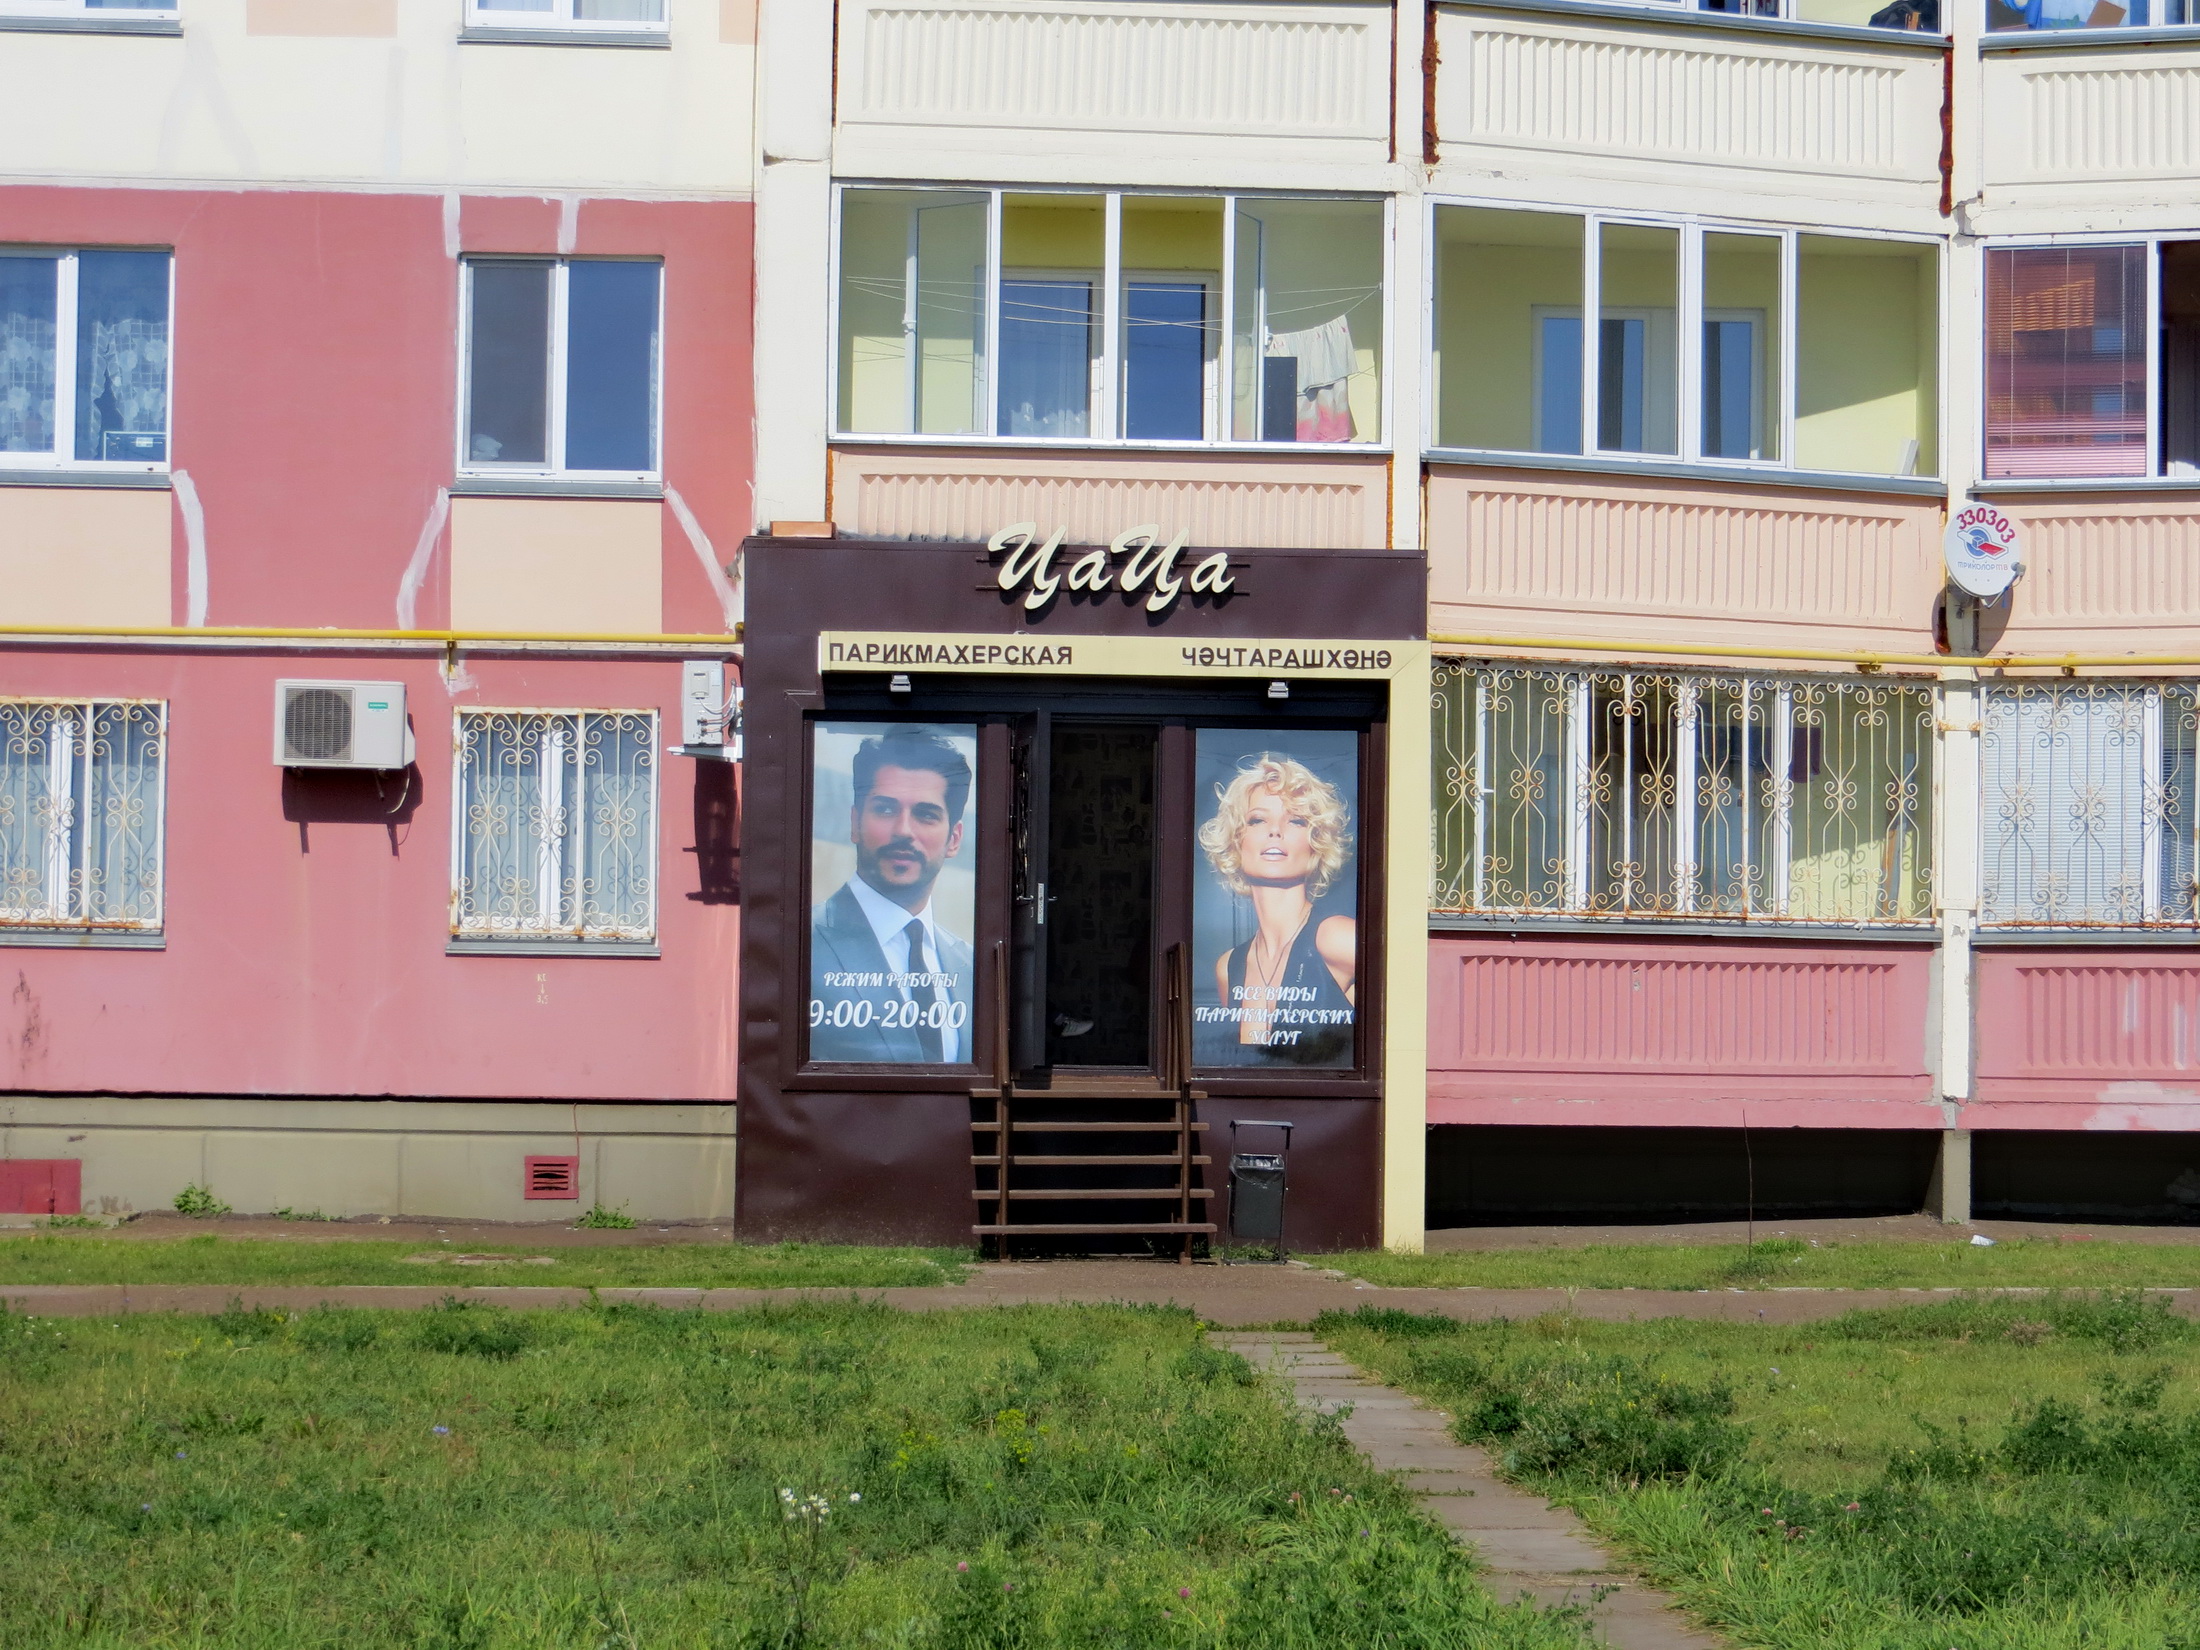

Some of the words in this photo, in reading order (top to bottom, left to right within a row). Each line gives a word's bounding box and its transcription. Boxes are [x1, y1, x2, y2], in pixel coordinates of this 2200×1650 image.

[1956, 508, 2015, 543] 330303
[830, 643, 1073, 665] ПАРИКМАХЕРСКАЯ
[1182, 647, 1392, 669] ЧӘЧТАРАШХӘНӘ
[824, 972, 883, 987] РЕЖИМ
[886, 972, 959, 988] РАБОТЫ
[1232, 986, 1262, 1001] ВСЕ
[1264, 986, 1317, 1002] ВИДЫ
[810, 999, 967, 1028] 9:00-20:00
[1195, 1007, 1353, 1024] ПАРИКМАХЕРСКИХ
[1248, 1030, 1302, 1046] УСЛУГ
